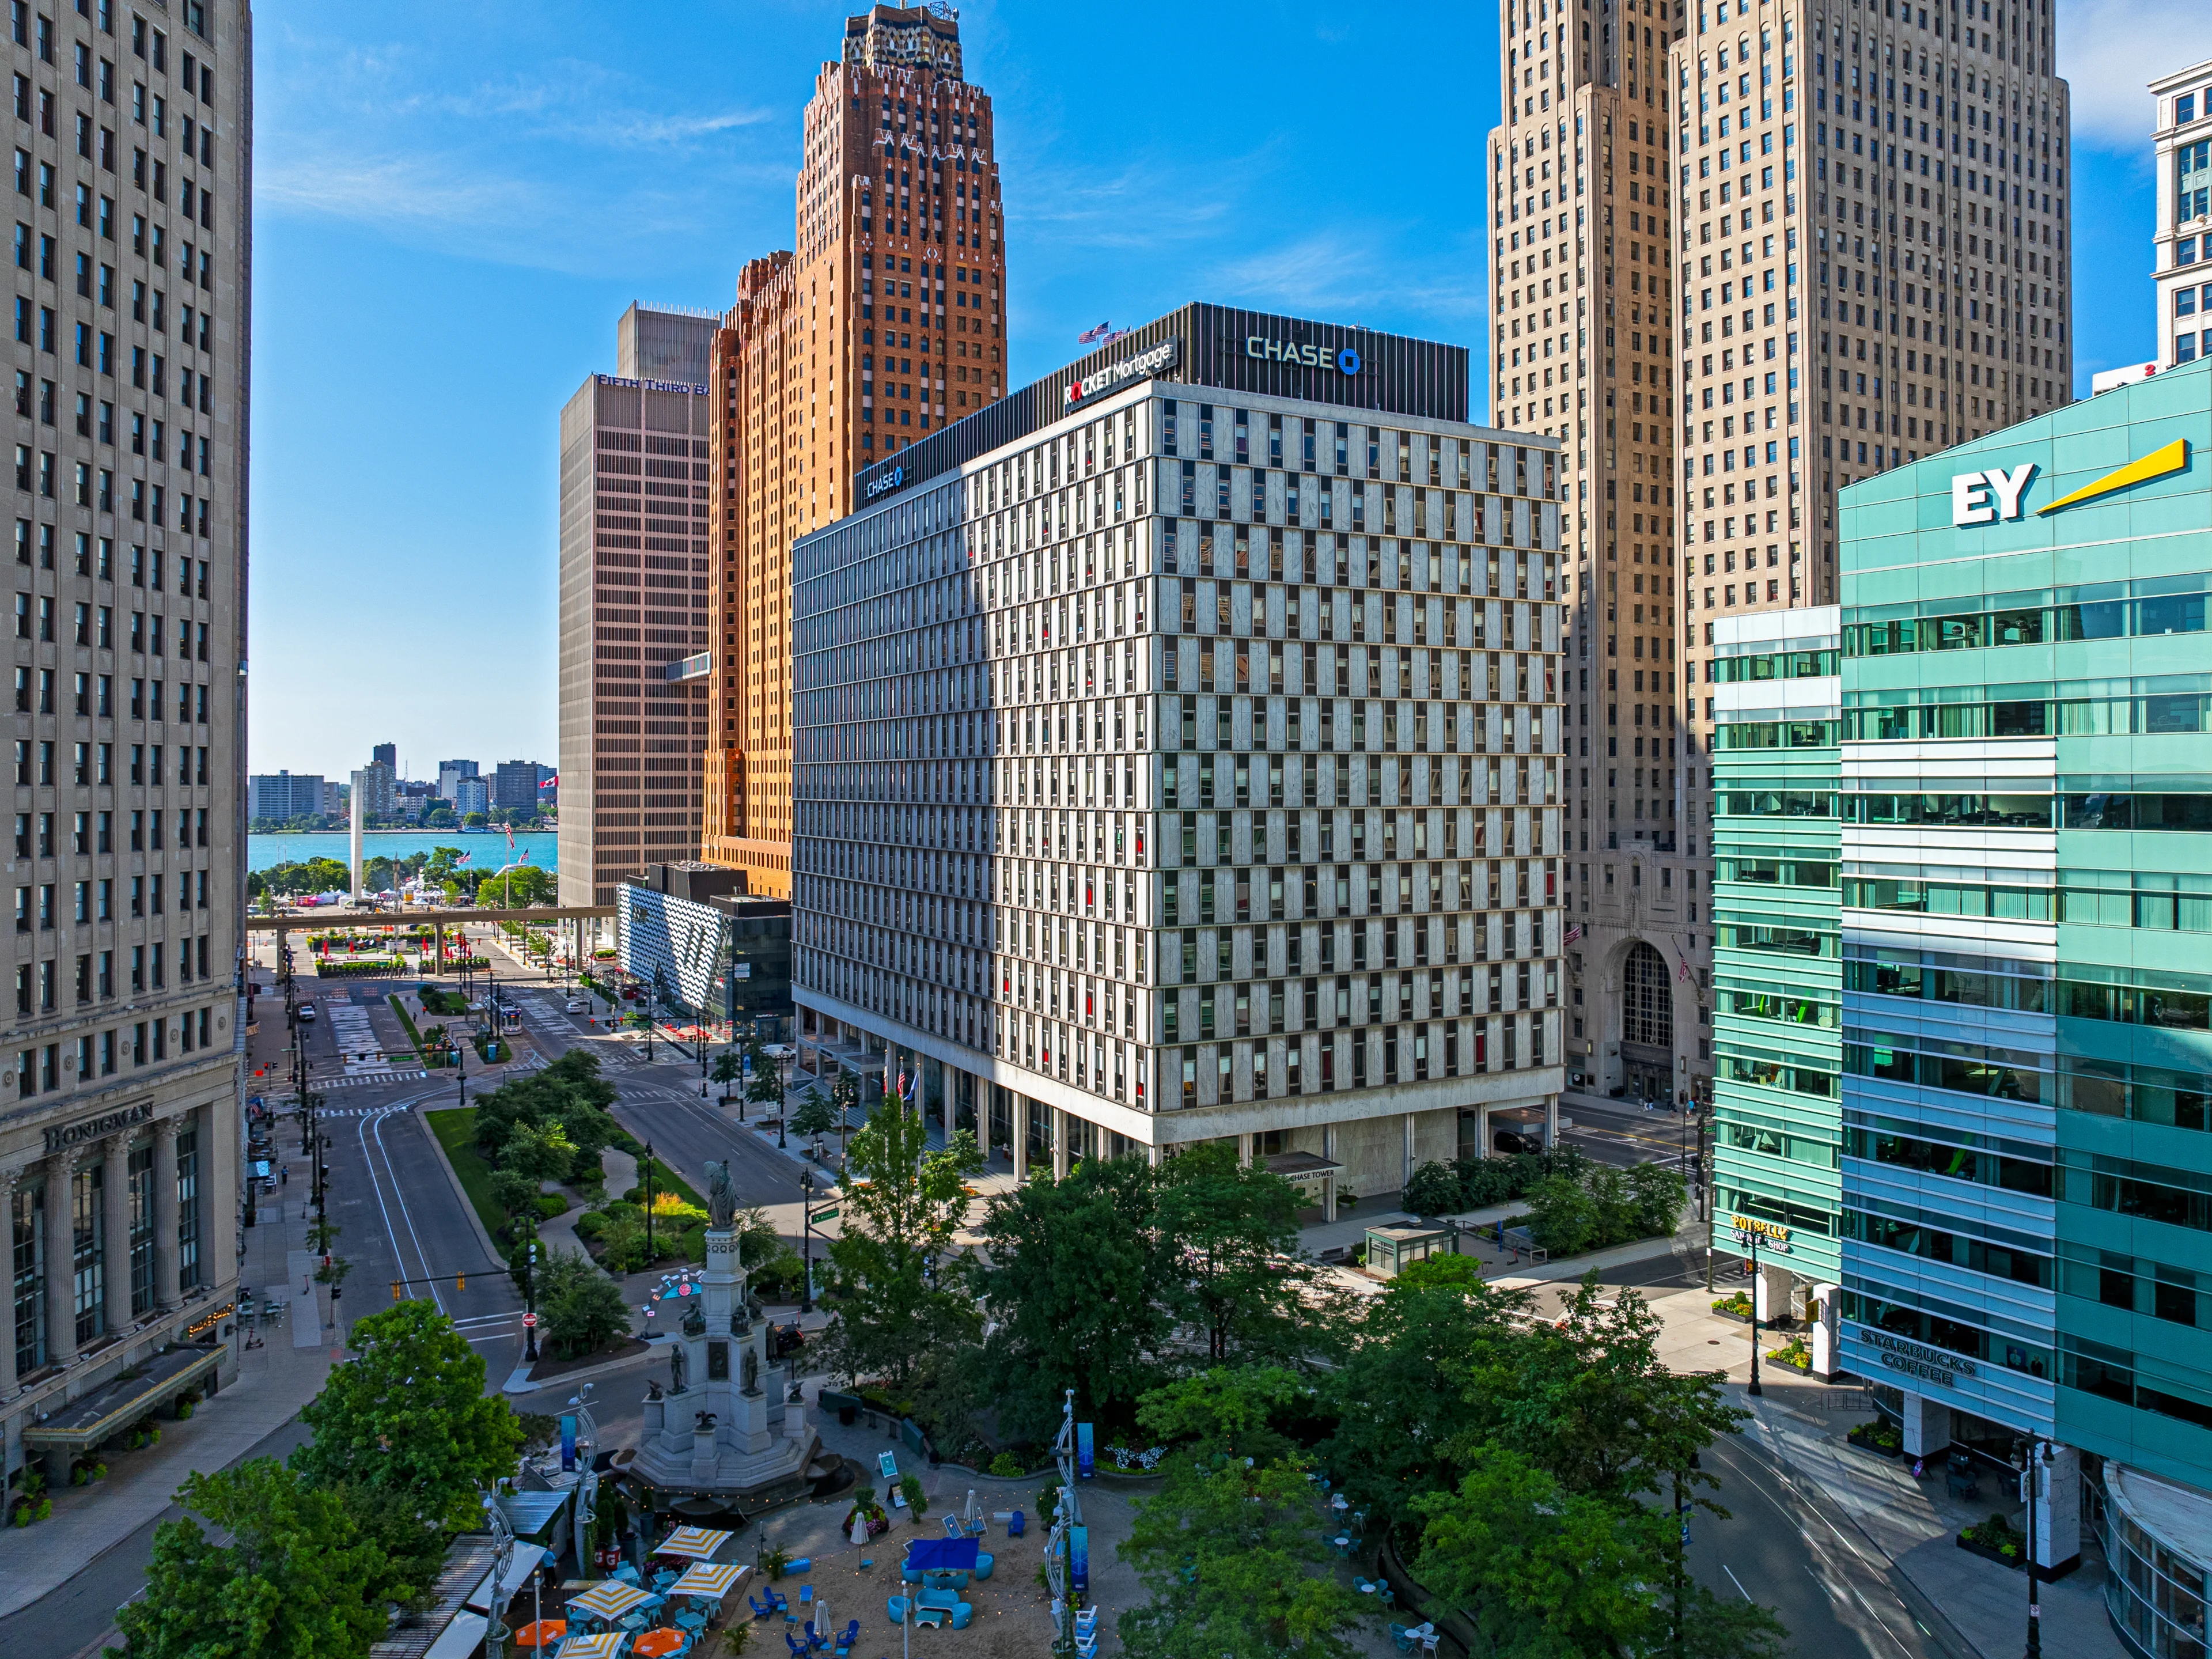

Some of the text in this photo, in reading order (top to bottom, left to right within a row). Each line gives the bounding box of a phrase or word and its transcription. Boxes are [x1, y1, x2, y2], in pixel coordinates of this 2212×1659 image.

[1247, 336, 1334, 369] CHASE
[598, 374, 640, 388] FIFTH
[645, 379, 690, 394] THIRD
[1065, 343, 1172, 405] ROCKET Mortgage
[2145, 364, 2156, 377] 2
[868, 472, 893, 497] CHASE
[1952, 463, 2035, 525] EY
[43, 1101, 155, 1154] HONIGMAN
[1291, 1169, 1334, 1181] CHASE TOWER
[1730, 1214, 1789, 1241] POTBELLY
[1768, 1240, 1789, 1252] SHOP
[189, 1302, 236, 1338] SHAKE SHACK
[1860, 1329, 1976, 1376] STARBUCKS
[1880, 1353, 1953, 1388] COFFEE
[607, 1554, 616, 1566] G
